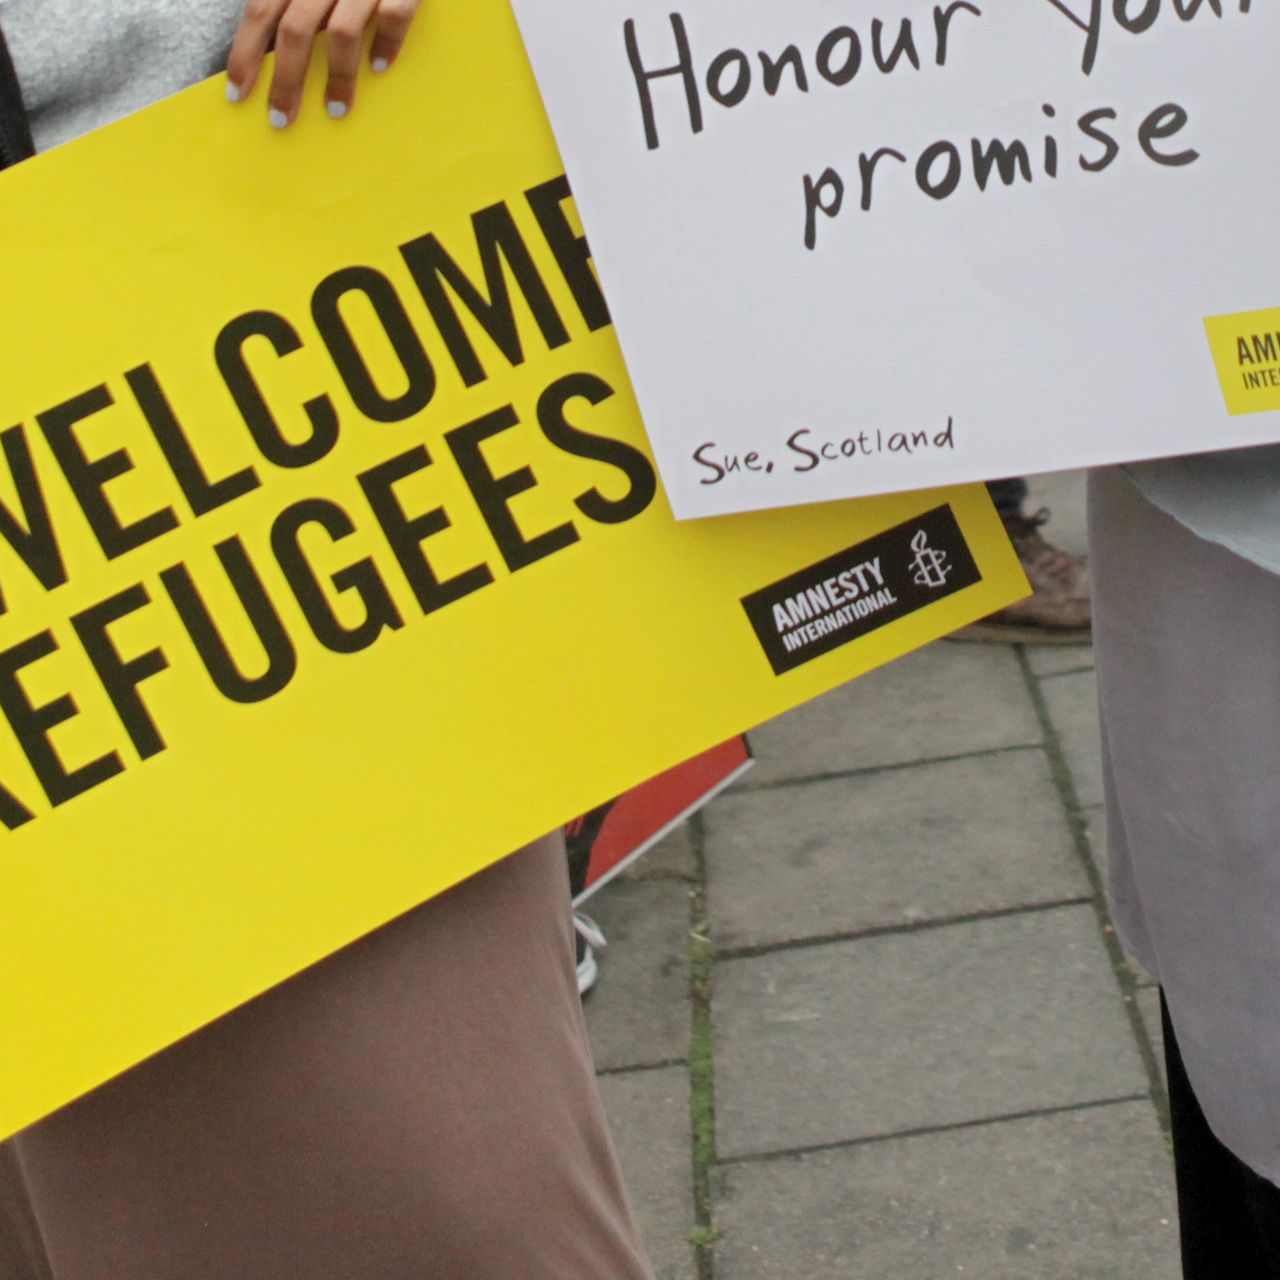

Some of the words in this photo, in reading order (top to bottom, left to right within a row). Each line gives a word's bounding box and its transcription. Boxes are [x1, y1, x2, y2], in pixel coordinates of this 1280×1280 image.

[623, 0, 982, 151] Honour
[802, 103, 1200, 251] promise
[692, 442, 774, 485] Sue,
[786, 416, 954, 473] Scotland
[772, 556, 884, 633] AMNESTY
[782, 587, 897, 653] INTERNATIONAL
